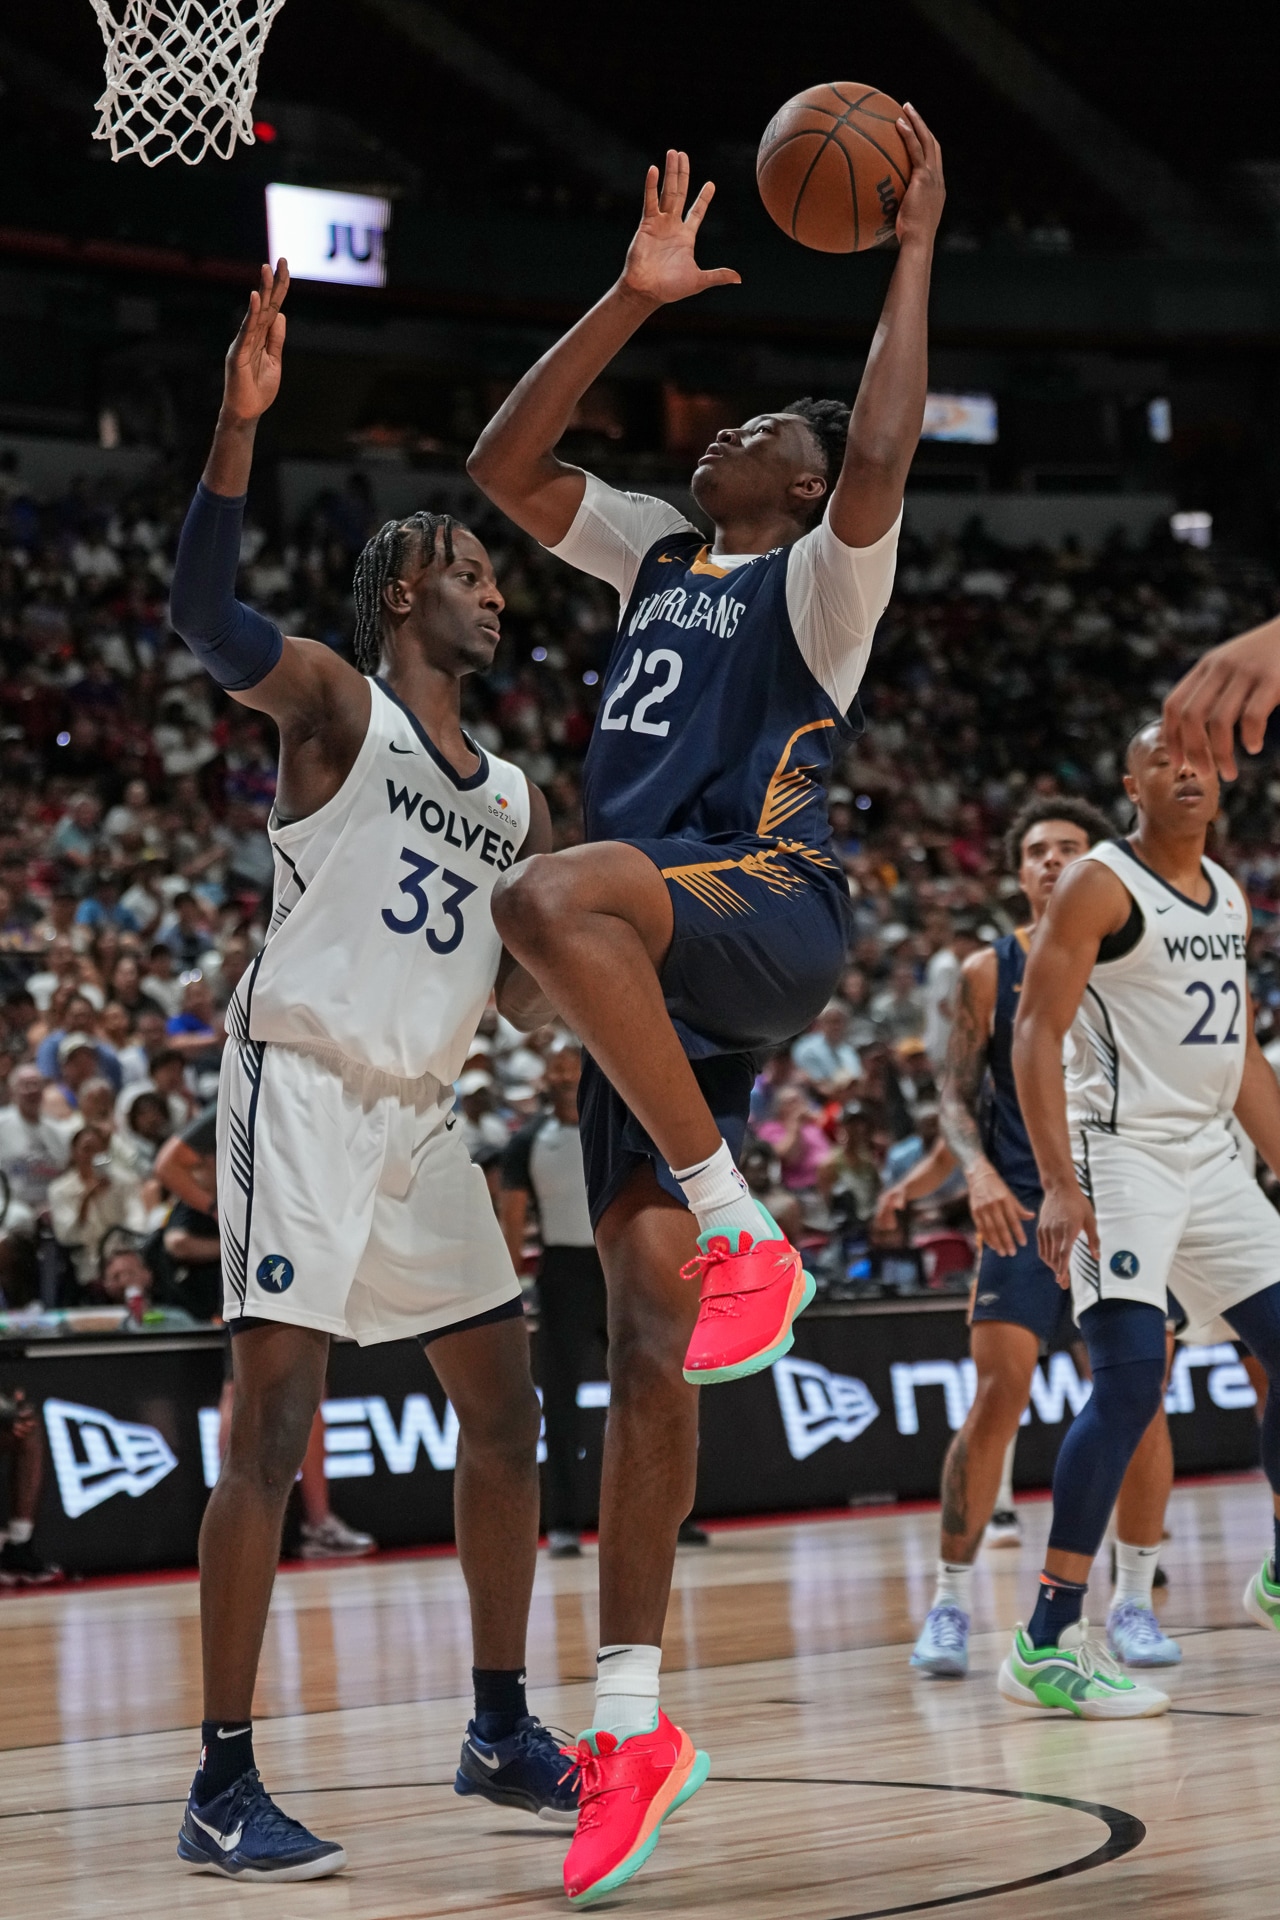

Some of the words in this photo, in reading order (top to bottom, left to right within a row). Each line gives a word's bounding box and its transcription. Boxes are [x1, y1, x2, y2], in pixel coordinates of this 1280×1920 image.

[600, 648, 683, 737] 22
[386, 779, 515, 872] WOLVES
[488, 805, 517, 828] sezzle
[381, 846, 478, 955] 33
[1180, 980, 1241, 1045] 22
